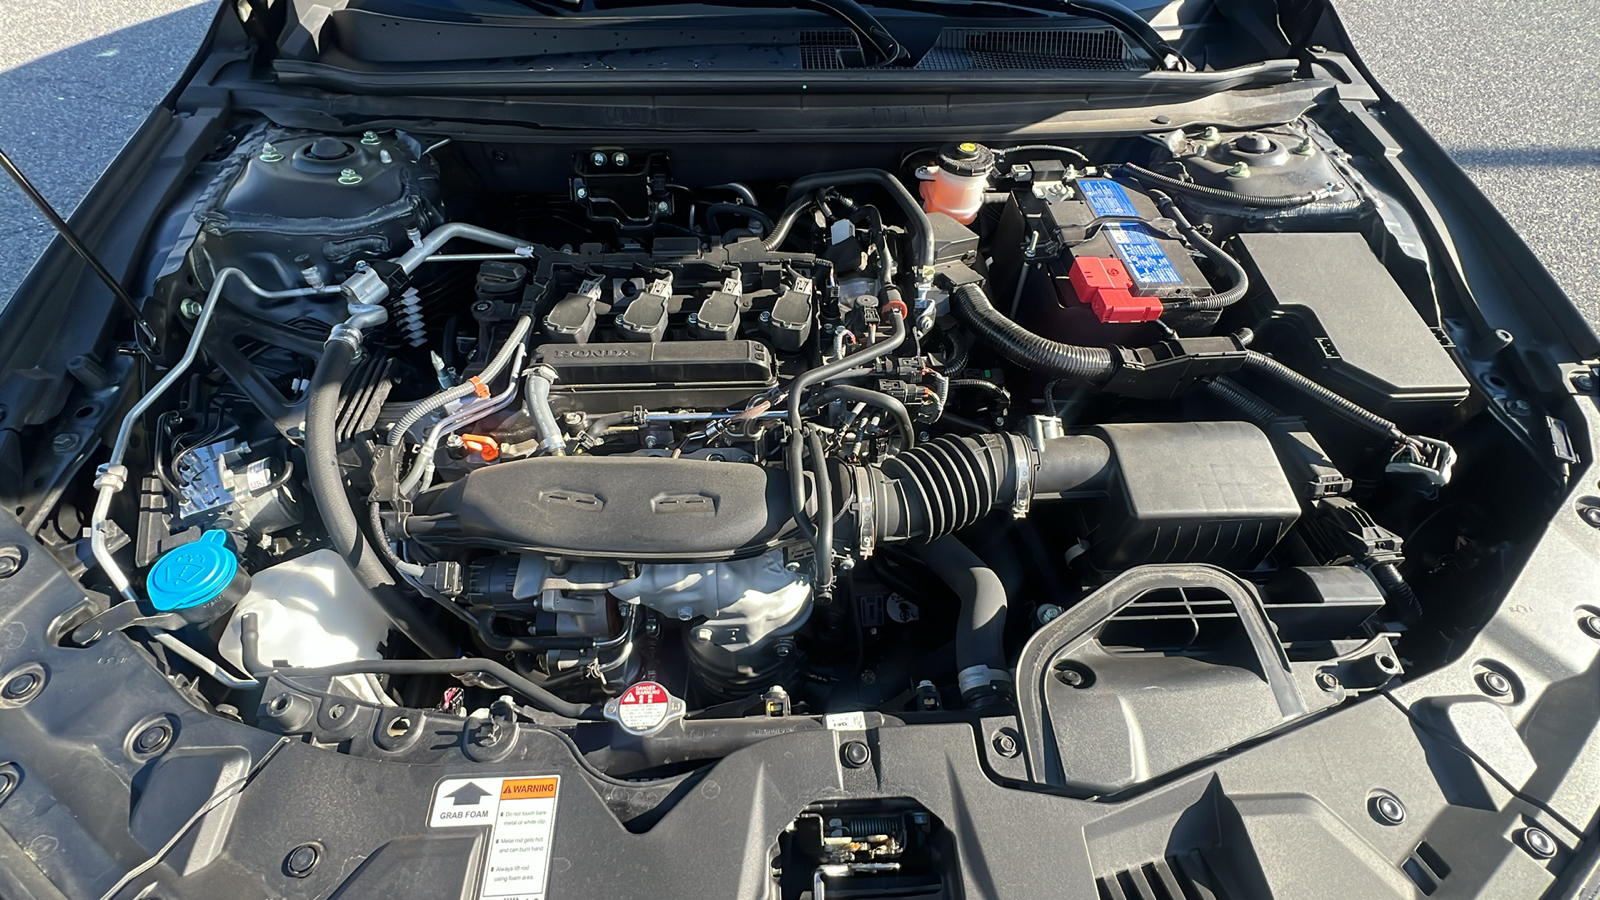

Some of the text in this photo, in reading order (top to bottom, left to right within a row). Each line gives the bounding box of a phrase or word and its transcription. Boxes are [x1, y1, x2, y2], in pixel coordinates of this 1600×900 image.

[554, 349, 637, 358] HONDA
[513, 784, 554, 793] WARNING
[440, 810, 489, 820] GRAB FOAM
